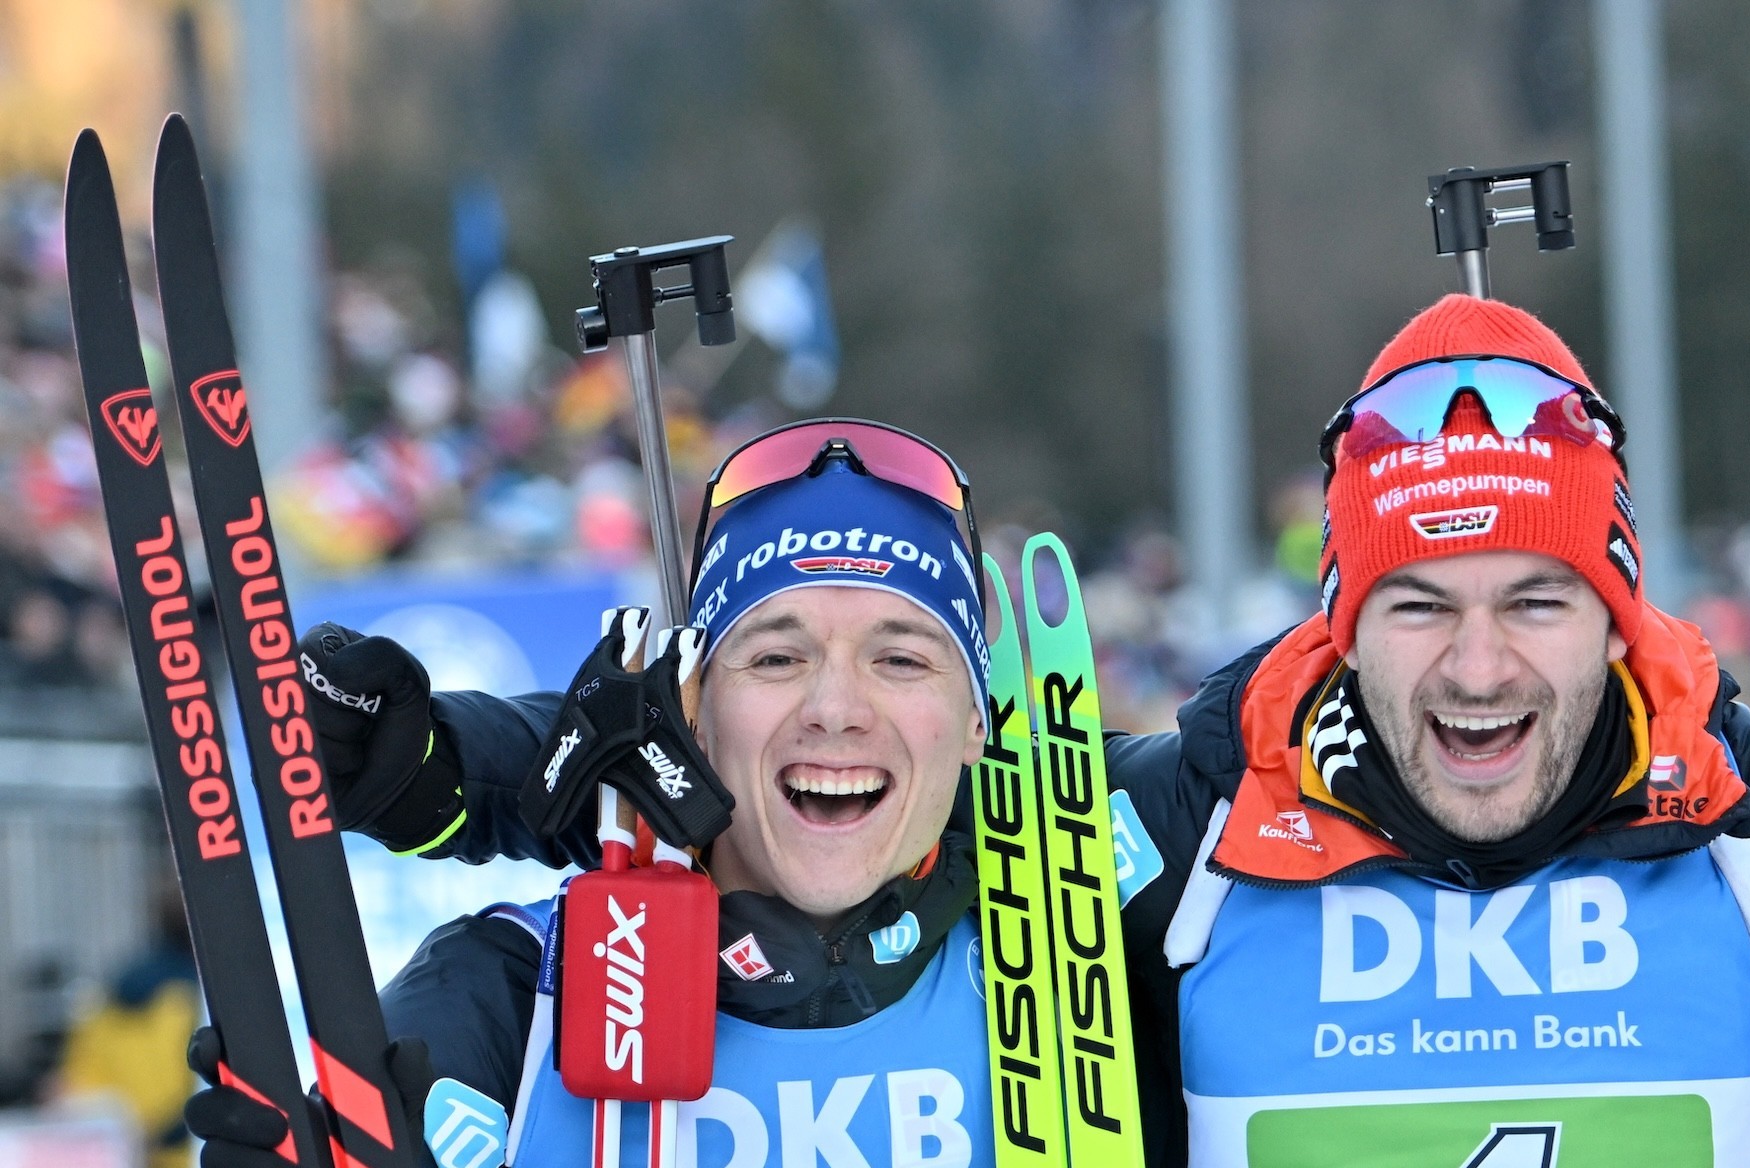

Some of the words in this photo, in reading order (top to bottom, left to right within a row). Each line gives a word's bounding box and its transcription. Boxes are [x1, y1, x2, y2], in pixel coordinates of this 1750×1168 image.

[735, 526, 944, 584] robotron
[1374, 474, 1550, 516] Wärmepumpen
[842, 557, 892, 576] DSV
[135, 515, 242, 861] ROSSIGNOL
[224, 495, 333, 839] ROSSIGNOL
[980, 694, 1046, 1155] FISCHER
[1042, 671, 1122, 1135] FISCHER
[1319, 875, 1640, 1003] DKB
[1313, 1022, 1397, 1059] Das
[1412, 1018, 1518, 1054] kann
[1533, 1011, 1643, 1050] Bank
